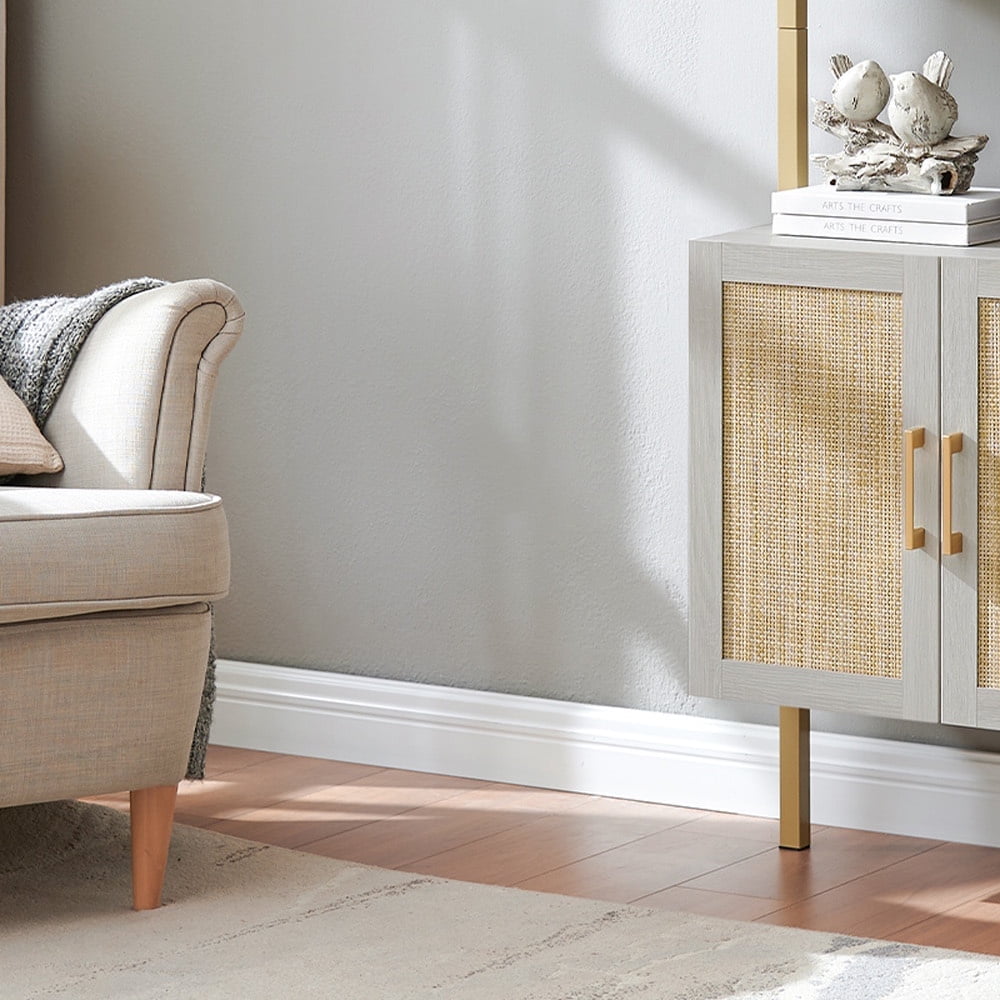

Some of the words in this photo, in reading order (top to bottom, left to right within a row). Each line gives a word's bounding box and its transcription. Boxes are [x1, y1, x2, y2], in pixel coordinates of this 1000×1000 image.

[822, 201, 844, 211] ARTS
[848, 202, 865, 212] THE
[869, 203, 903, 214] CRAFTS
[823, 222, 845, 232] ARTS
[850, 223, 866, 233] THE
[870, 224, 904, 235] CRAFTS
